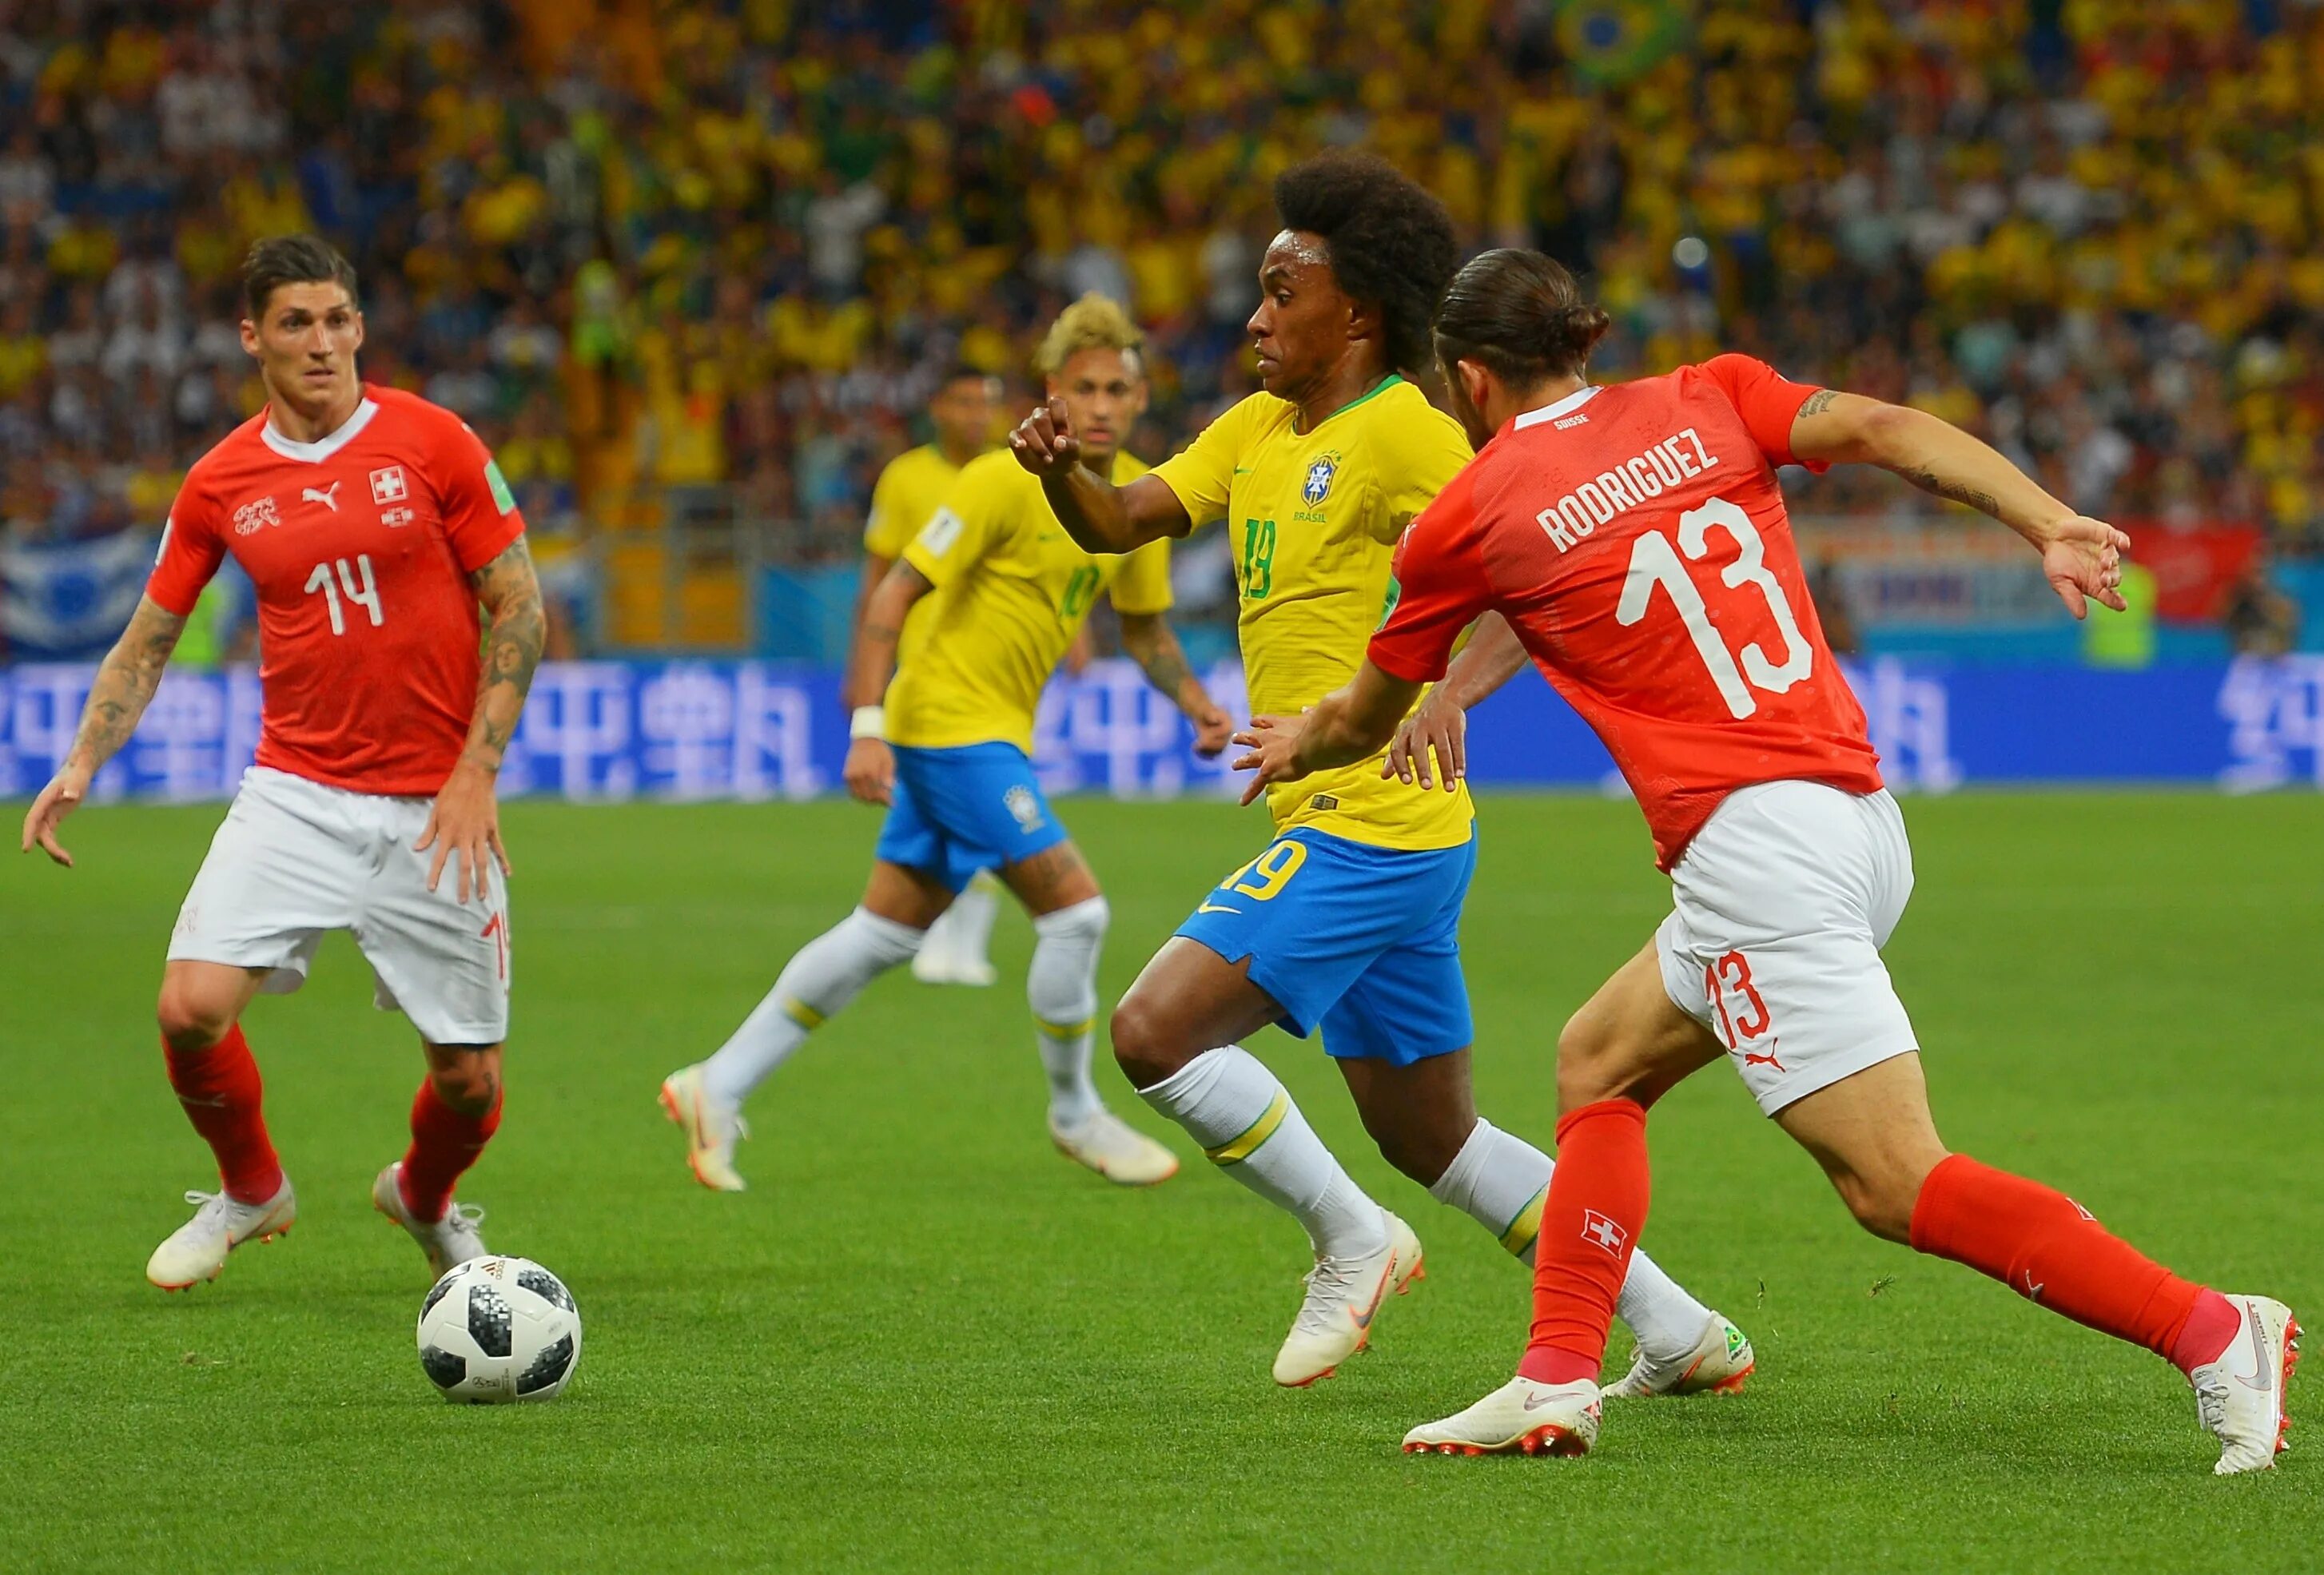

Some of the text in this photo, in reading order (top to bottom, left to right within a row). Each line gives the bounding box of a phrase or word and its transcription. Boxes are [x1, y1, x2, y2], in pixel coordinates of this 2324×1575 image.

[1553, 413, 1590, 431] SUISSE
[1293, 511, 1327, 523] BRASIL
[1535, 428, 1719, 554] RODRIGUEZ
[304, 553, 384, 636] 14
[1243, 518, 1276, 599] 19
[1615, 496, 1813, 720] 13
[1220, 839, 1307, 901] 19
[480, 909, 511, 981] 1
[1705, 949, 1770, 1049] 13
